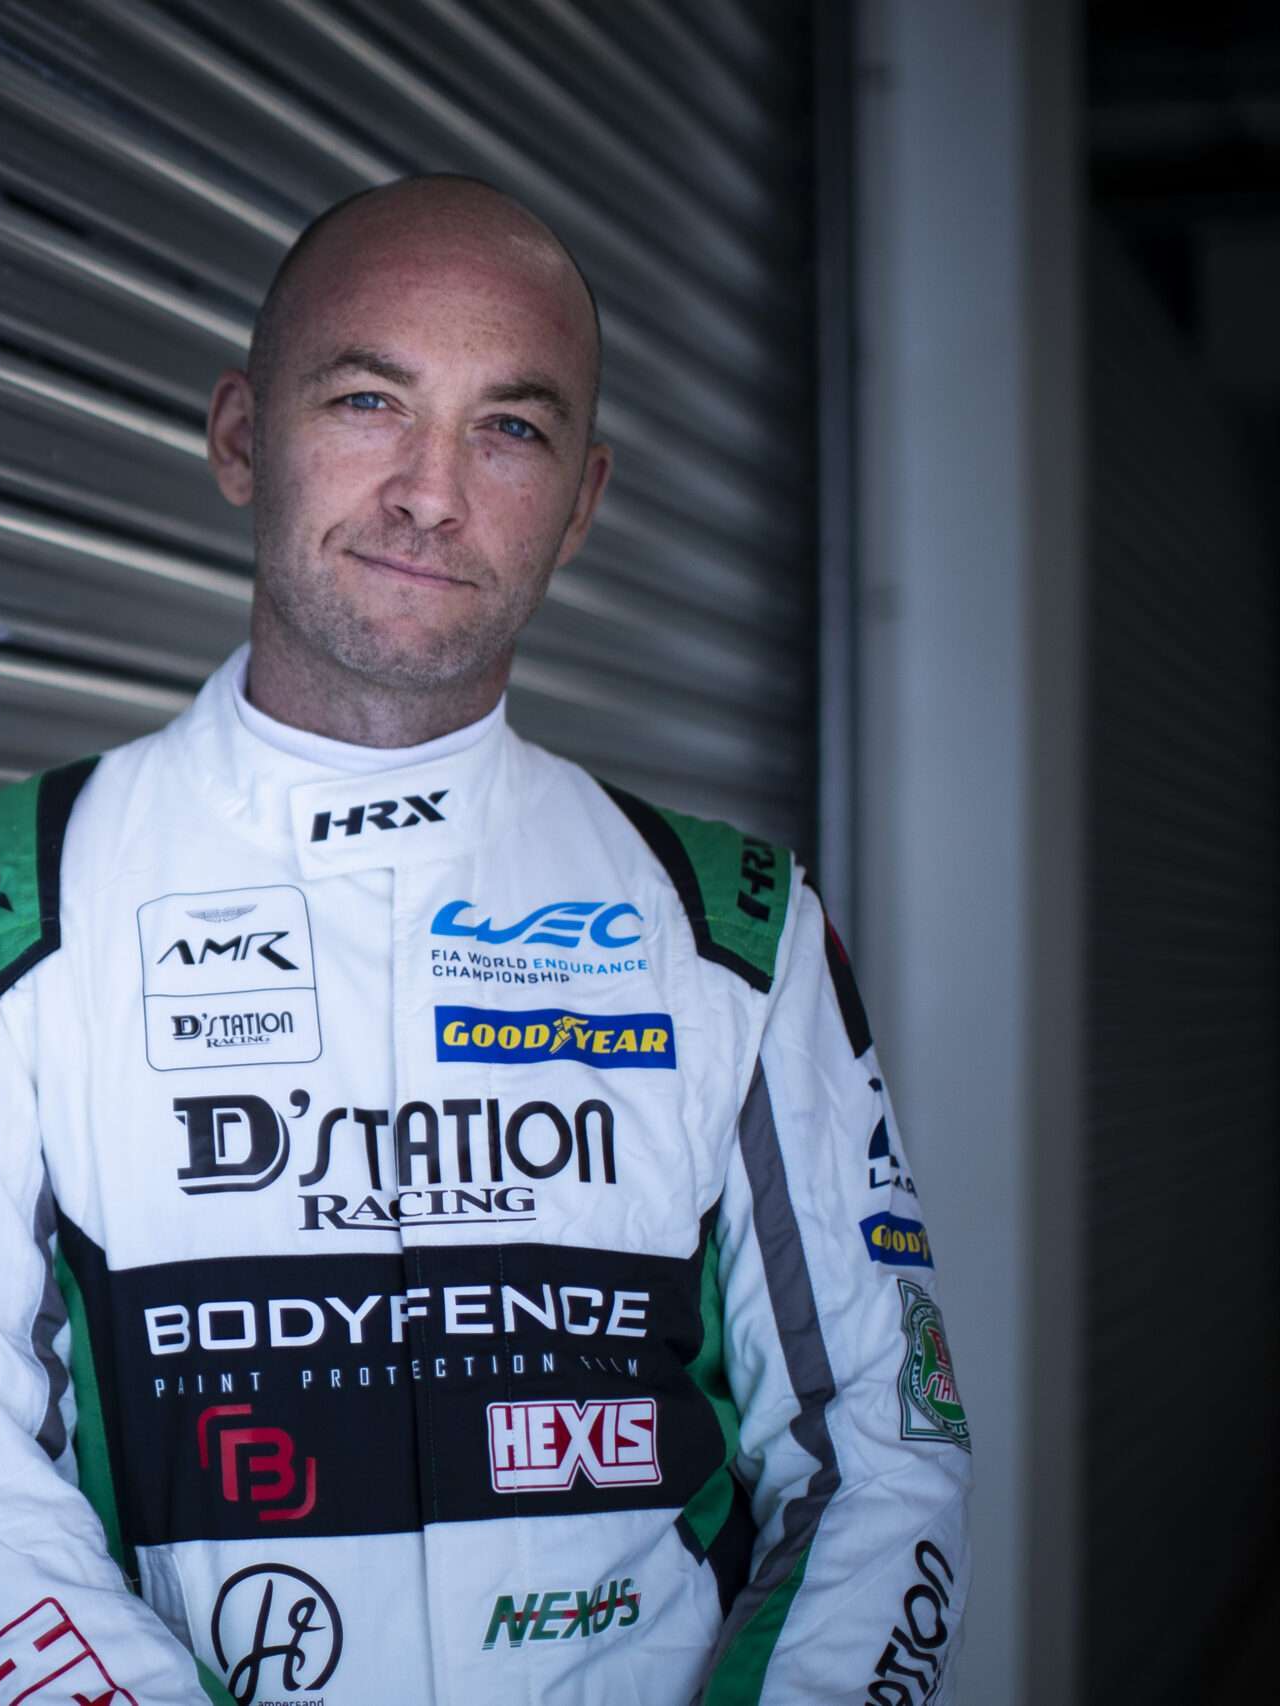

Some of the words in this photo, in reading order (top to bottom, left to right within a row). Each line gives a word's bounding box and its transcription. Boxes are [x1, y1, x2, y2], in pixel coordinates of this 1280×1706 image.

[310, 789, 451, 842] HRX
[736, 834, 775, 922] HR
[430, 900, 644, 948] WEC
[157, 931, 300, 970] AMR
[431, 949, 461, 962] FIA
[467, 951, 527, 969] WORLD
[533, 958, 649, 975] ENDURANCE
[432, 965, 570, 984] CHAMPIONSHIP
[206, 1035, 271, 1048] RACING
[442, 1020, 669, 1055] GOODYEAR
[299, 1186, 537, 1231] RACING
[144, 1283, 650, 1356] BODYFENCE
[154, 1371, 261, 1398] PAINT
[302, 1353, 555, 1389] PROTECTION
[490, 1402, 657, 1476] HEXIS
[482, 1579, 641, 1649] NEXUS
